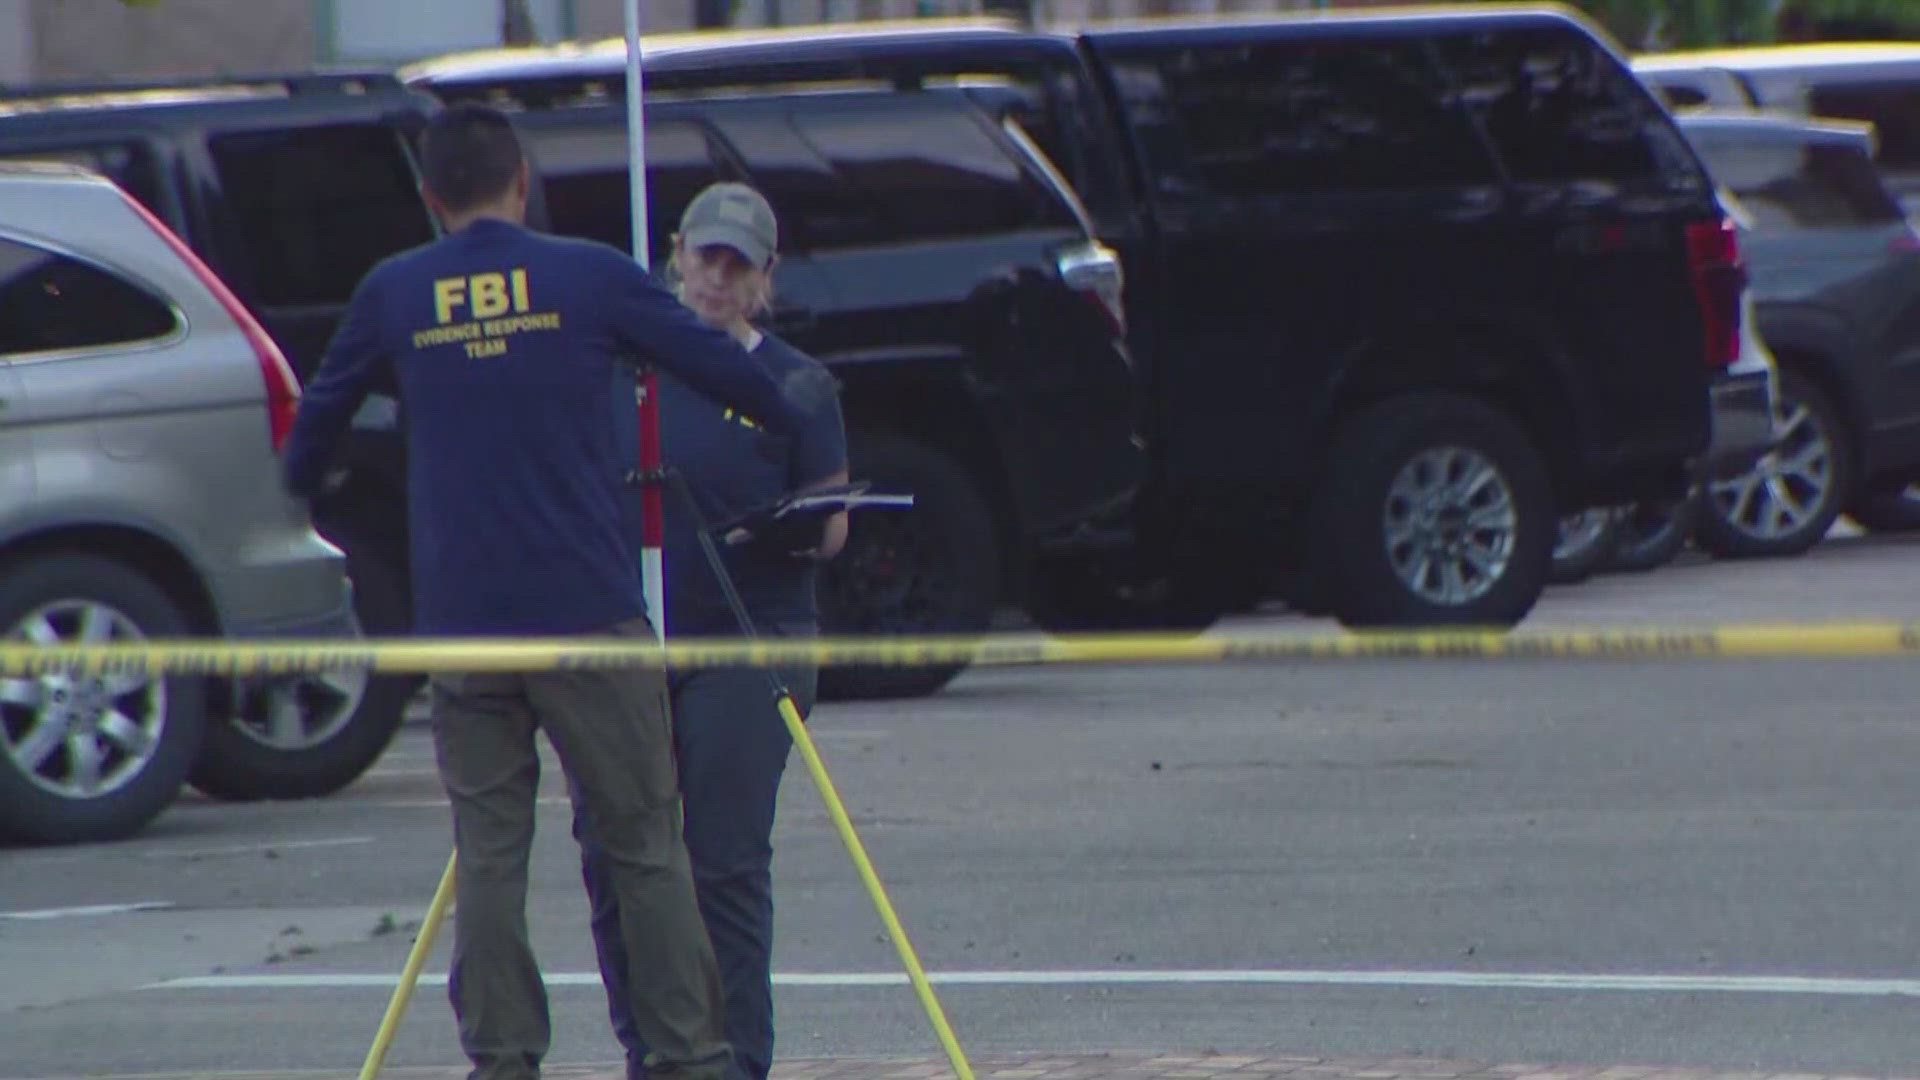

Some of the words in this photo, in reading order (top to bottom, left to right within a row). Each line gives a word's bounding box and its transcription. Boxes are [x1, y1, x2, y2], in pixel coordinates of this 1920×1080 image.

[434, 268, 530, 324] FBI
[413, 321, 482, 349] EVIDENCE
[483, 312, 561, 337] RESPONSE
[465, 338, 508, 360] TEAM
